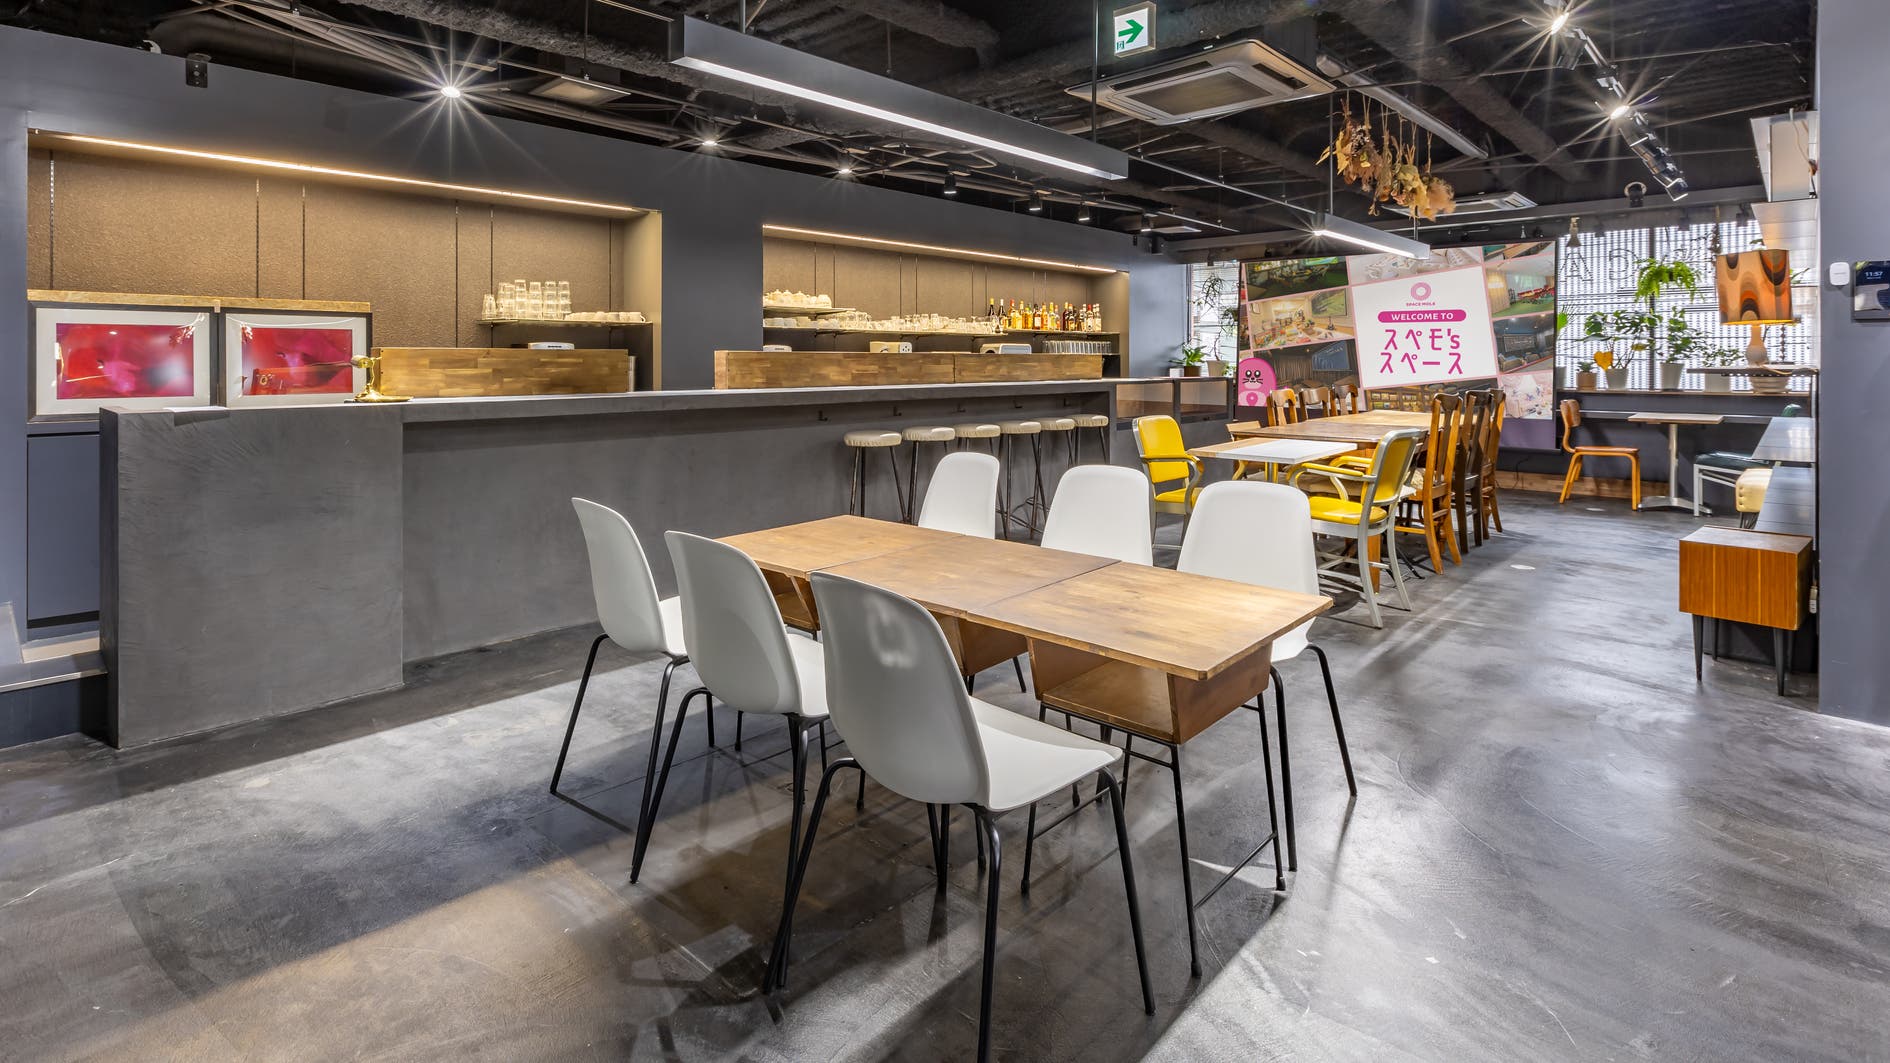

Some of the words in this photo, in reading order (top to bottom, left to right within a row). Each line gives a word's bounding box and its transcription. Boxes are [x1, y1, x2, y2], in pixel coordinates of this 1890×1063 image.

[1391, 313, 1438, 321] WELCOME
[1441, 312, 1454, 320] TO
[1380, 352, 1463, 375] スペース
